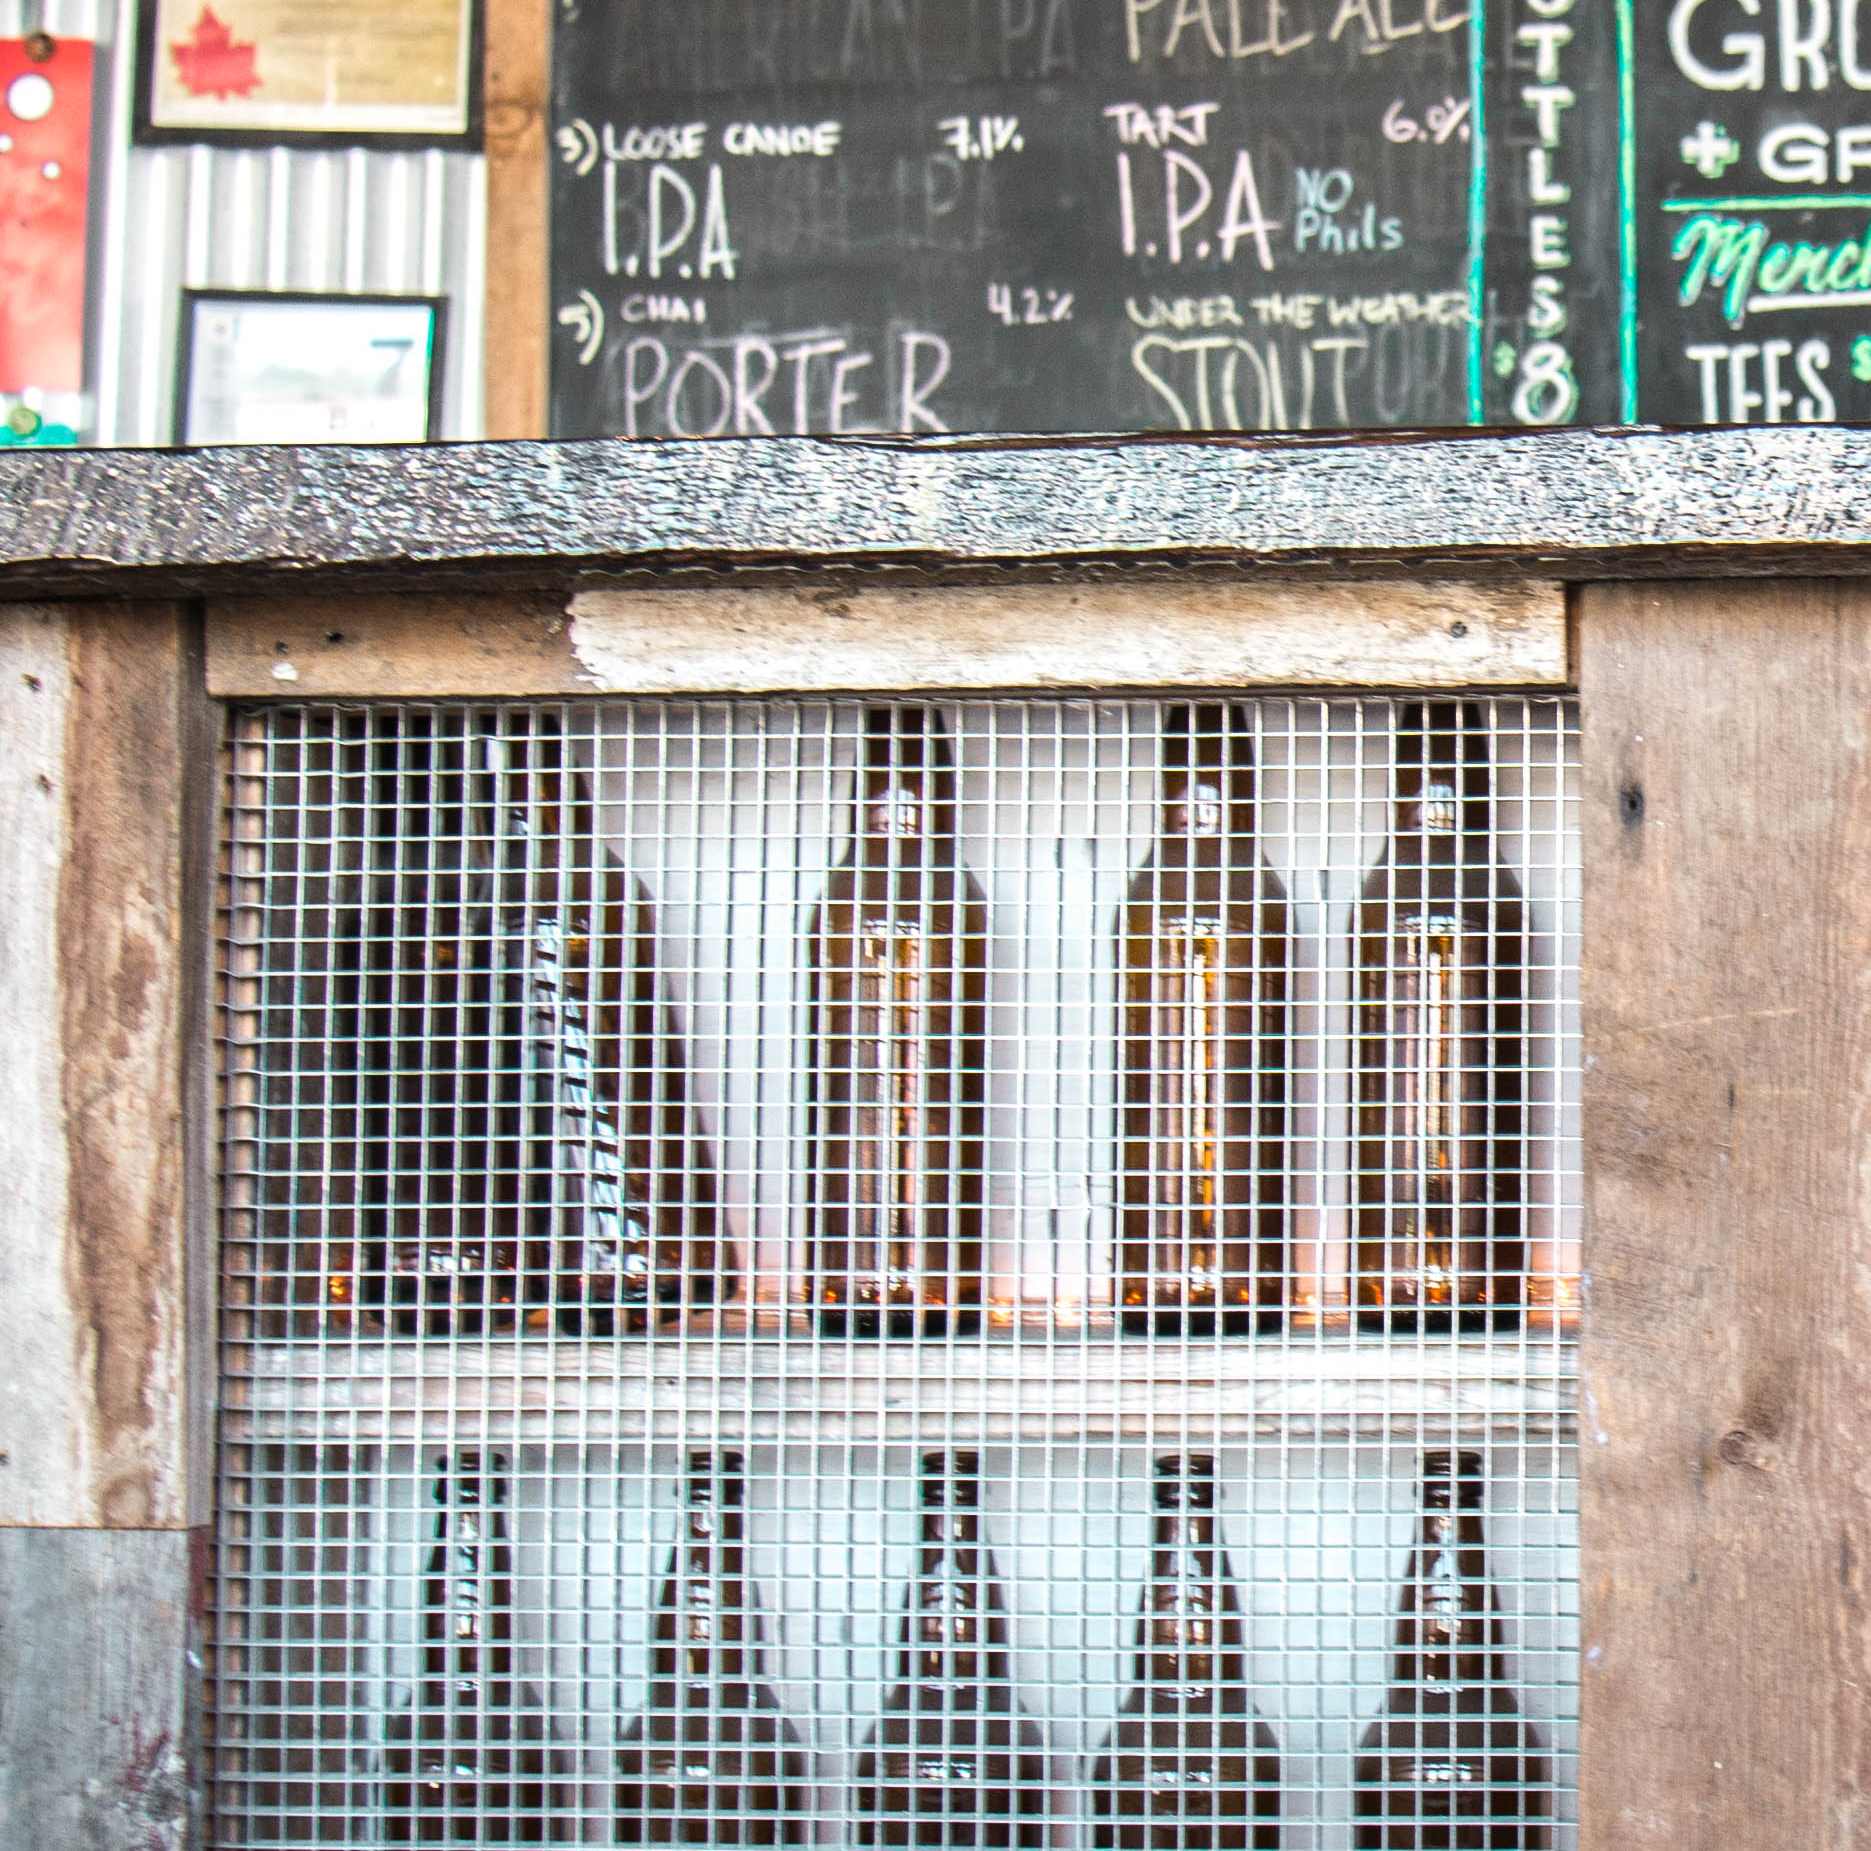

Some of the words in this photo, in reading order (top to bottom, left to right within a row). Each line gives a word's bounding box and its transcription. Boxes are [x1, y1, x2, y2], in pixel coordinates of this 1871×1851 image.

[603, 122, 708, 160] LOOSE
[723, 121, 843, 156] CANOE
[1102, 101, 1221, 149] TART
[1295, 165, 1354, 213] NO
[621, 293, 707, 325] CHAI
[1125, 294, 1243, 329] UNDER
[1248, 294, 1324, 331] THE
[1325, 292, 1483, 329] WEATHER
[625, 332, 953, 435] PORTER
[1130, 333, 1368, 432] STOUT
